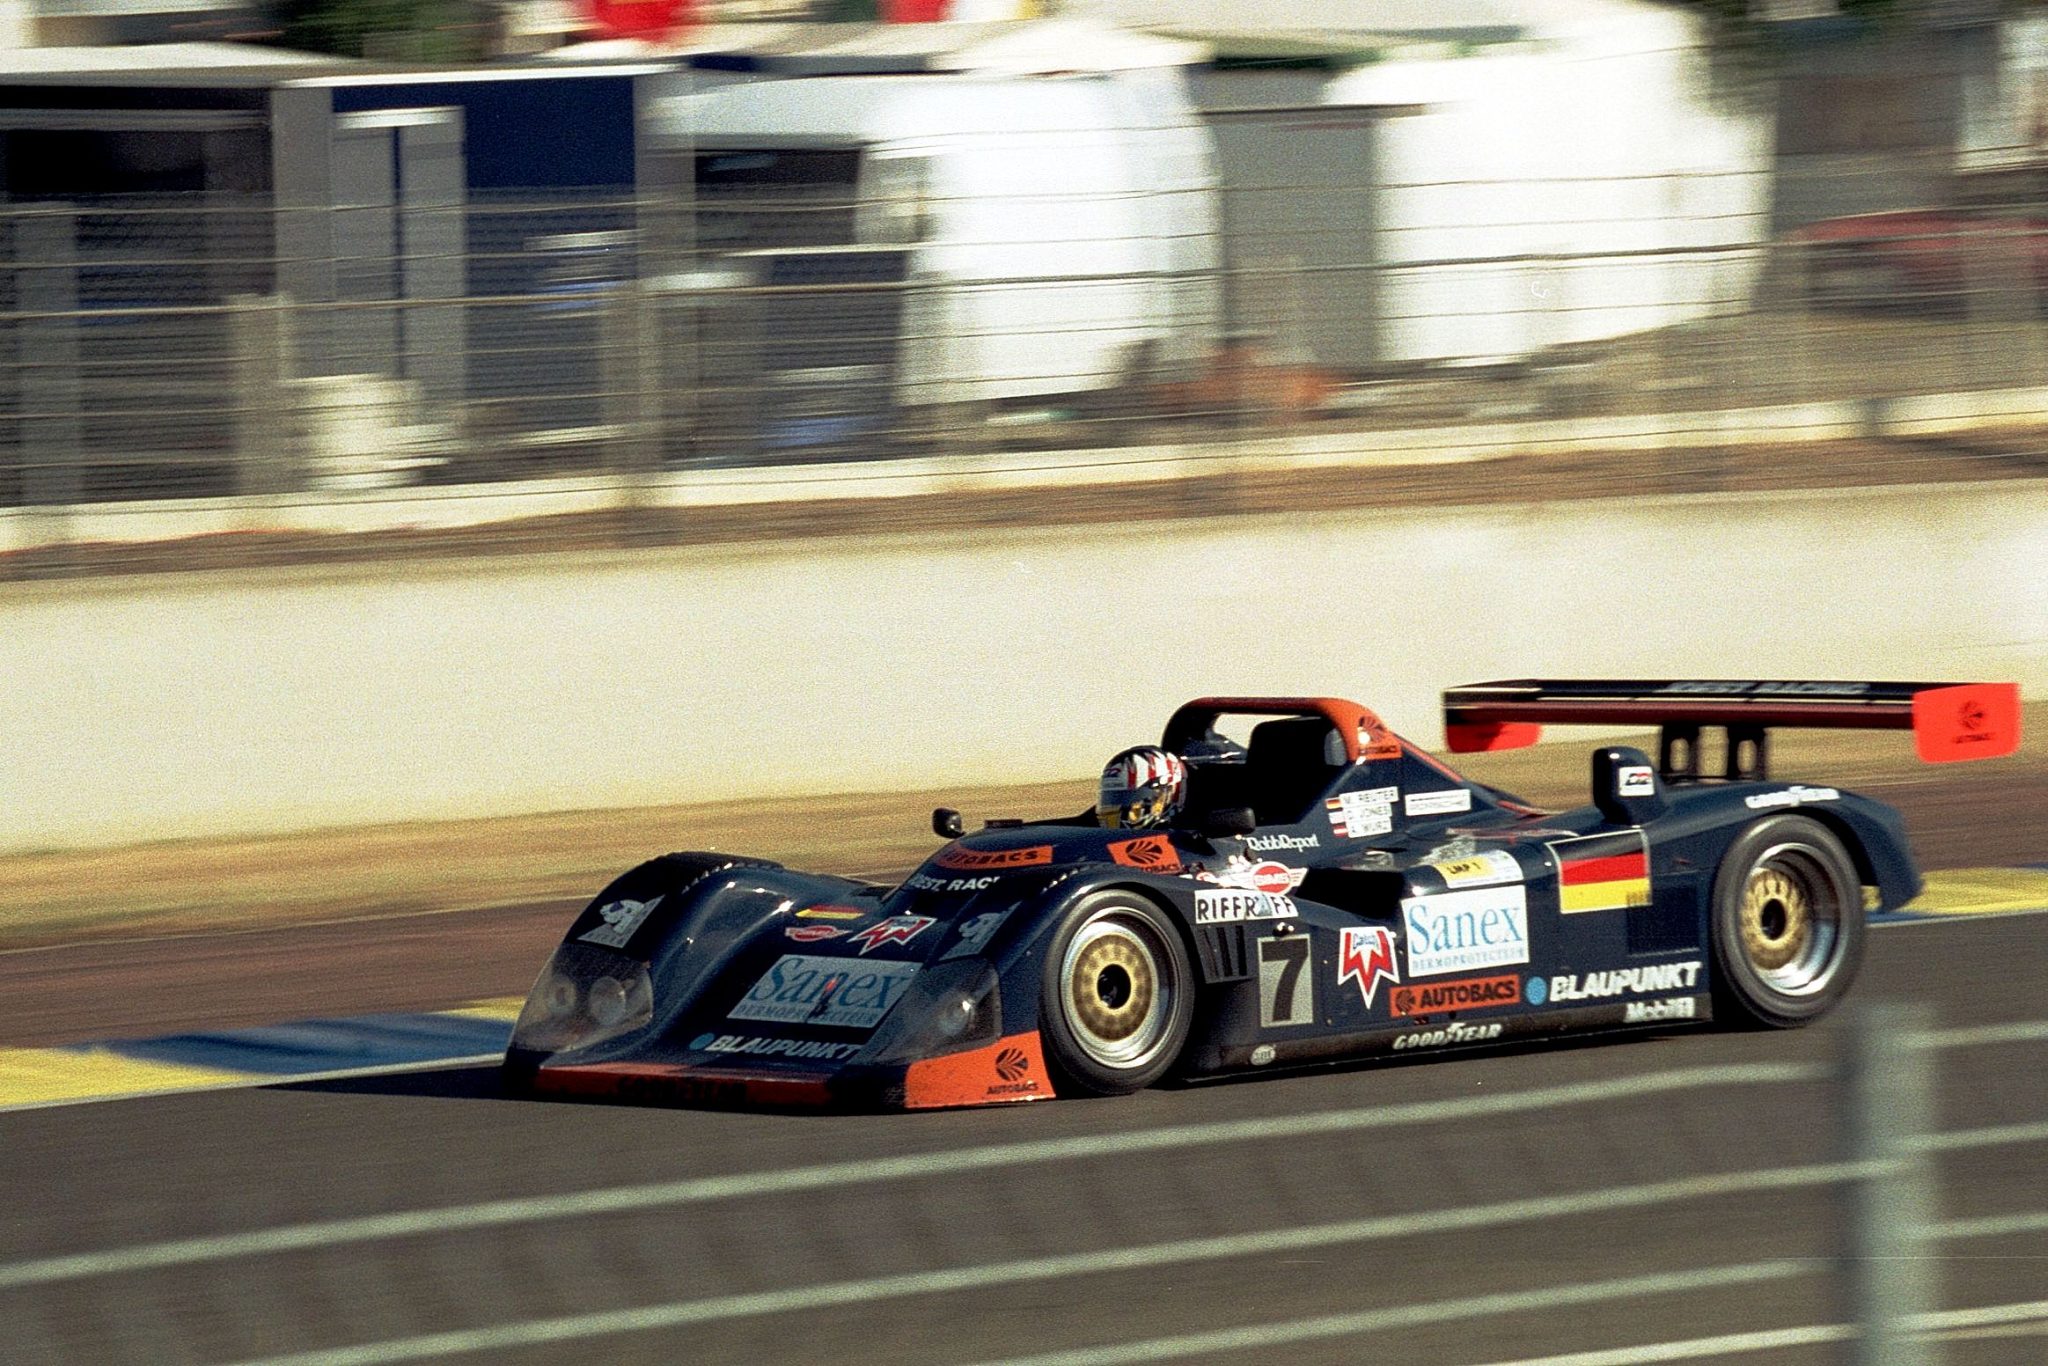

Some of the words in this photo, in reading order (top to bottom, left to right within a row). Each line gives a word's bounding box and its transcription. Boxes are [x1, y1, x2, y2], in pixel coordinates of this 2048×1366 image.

[1408, 904, 1523, 955] Sanex
[751, 957, 909, 1009] Sanex
[1261, 938, 1309, 1021] 7
[1420, 980, 1515, 1009] AUTOBACS
[1550, 961, 1703, 1002] BLAUPUNKT
[705, 1034, 864, 1060] BLAUPUNKT
